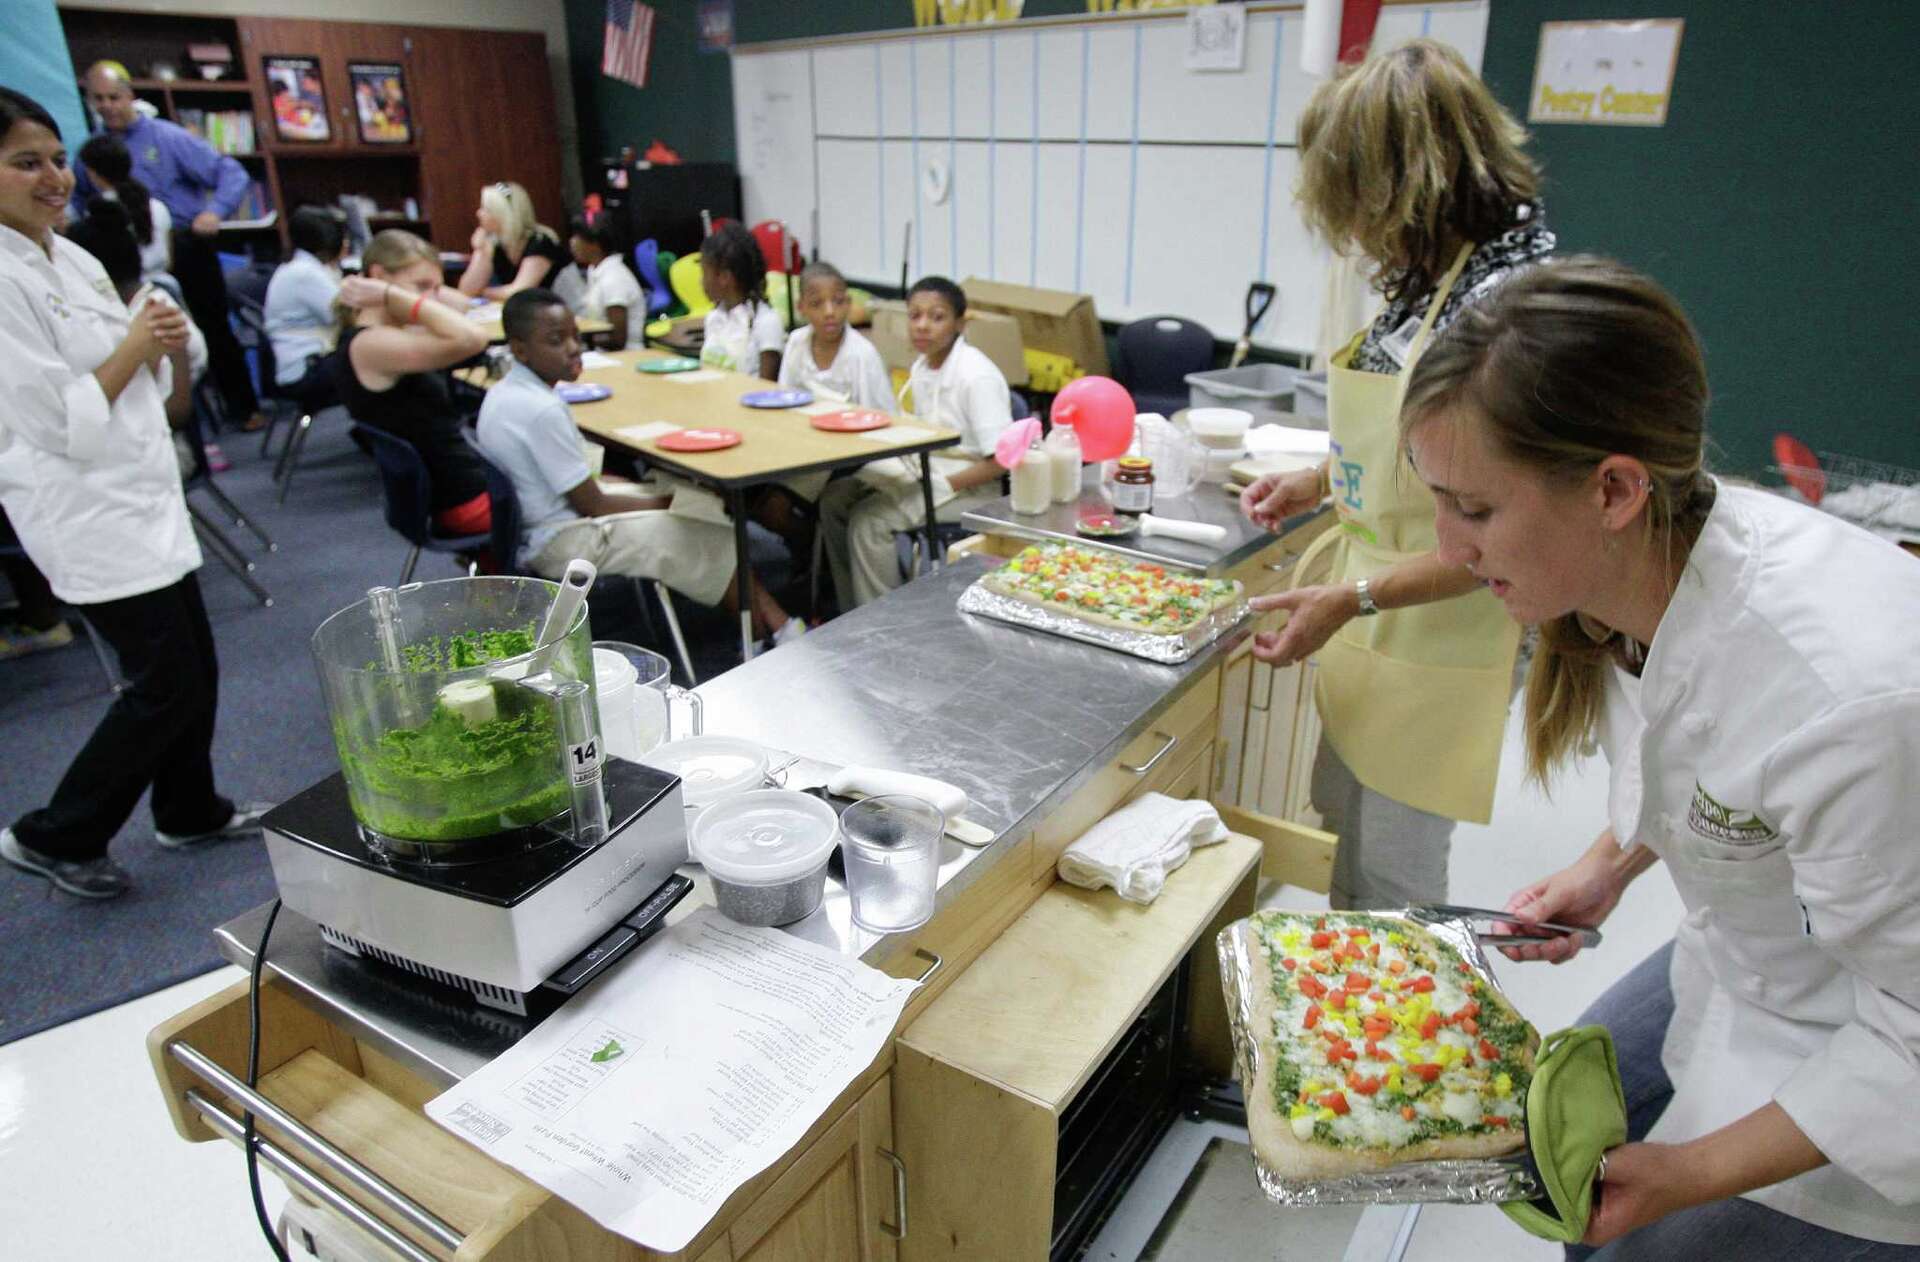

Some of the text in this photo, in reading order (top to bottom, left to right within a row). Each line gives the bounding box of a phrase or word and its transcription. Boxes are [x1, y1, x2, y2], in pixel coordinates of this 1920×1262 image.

[573, 741, 596, 764] 14
[587, 947, 603, 960] ON
[606, 1161, 631, 1183] Whole
